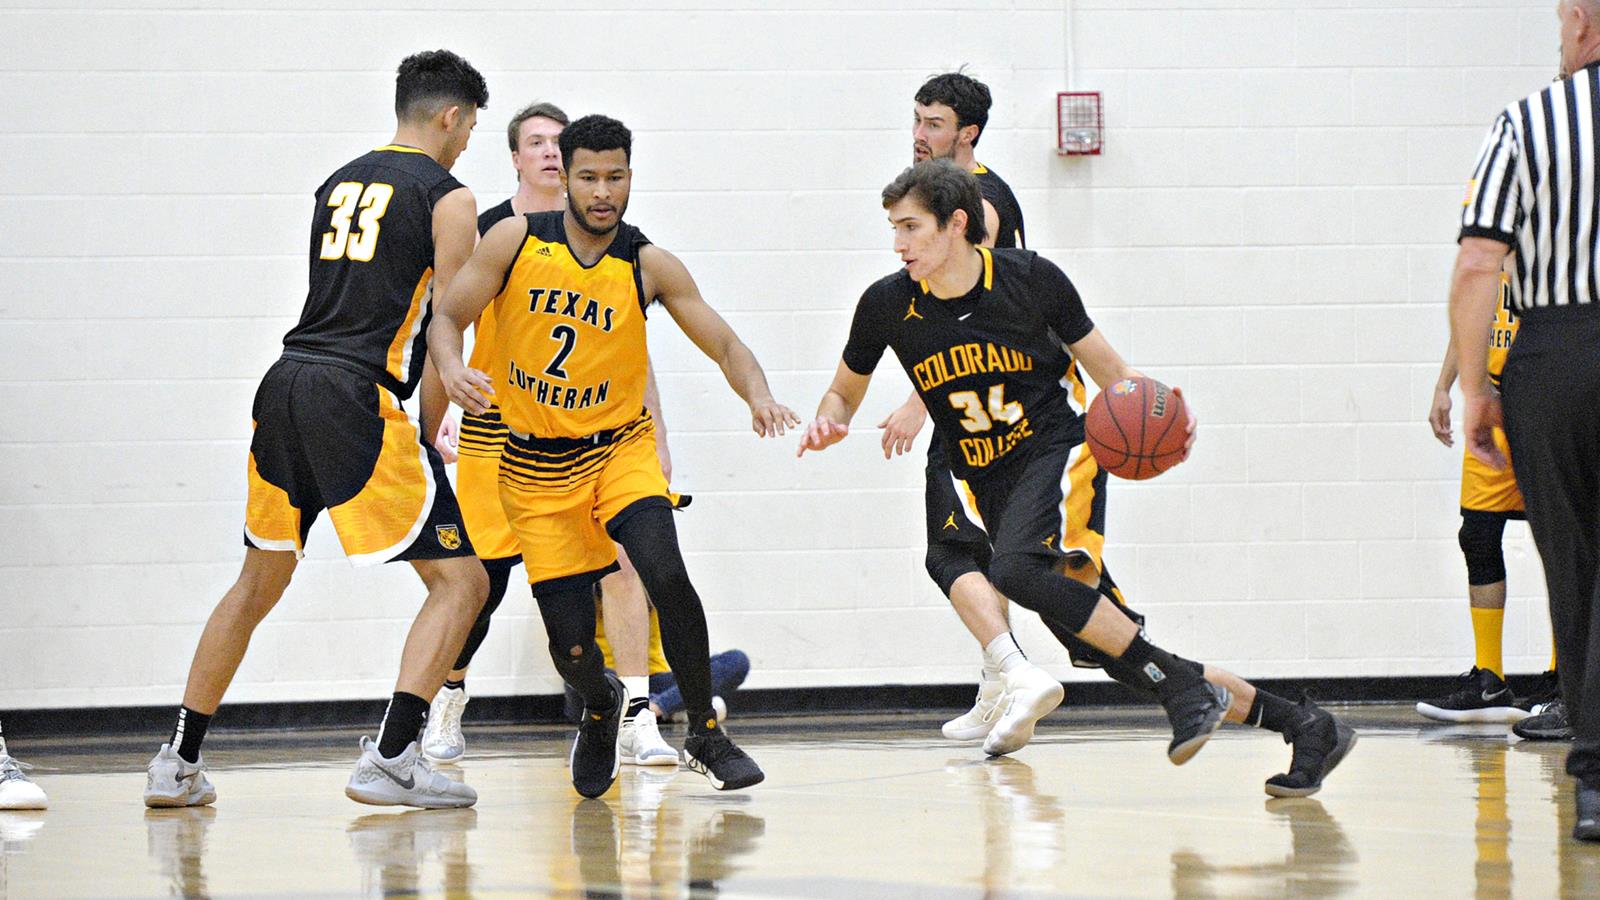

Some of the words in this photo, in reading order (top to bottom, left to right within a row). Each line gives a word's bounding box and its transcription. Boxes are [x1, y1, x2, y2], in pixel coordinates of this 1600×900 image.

[320, 181, 395, 262] 33
[529, 288, 616, 332] TEXAS
[544, 324, 577, 380] 2
[913, 341, 1033, 392] COLORADO
[508, 359, 610, 409] LUTHERAN
[948, 383, 1024, 433] 34
